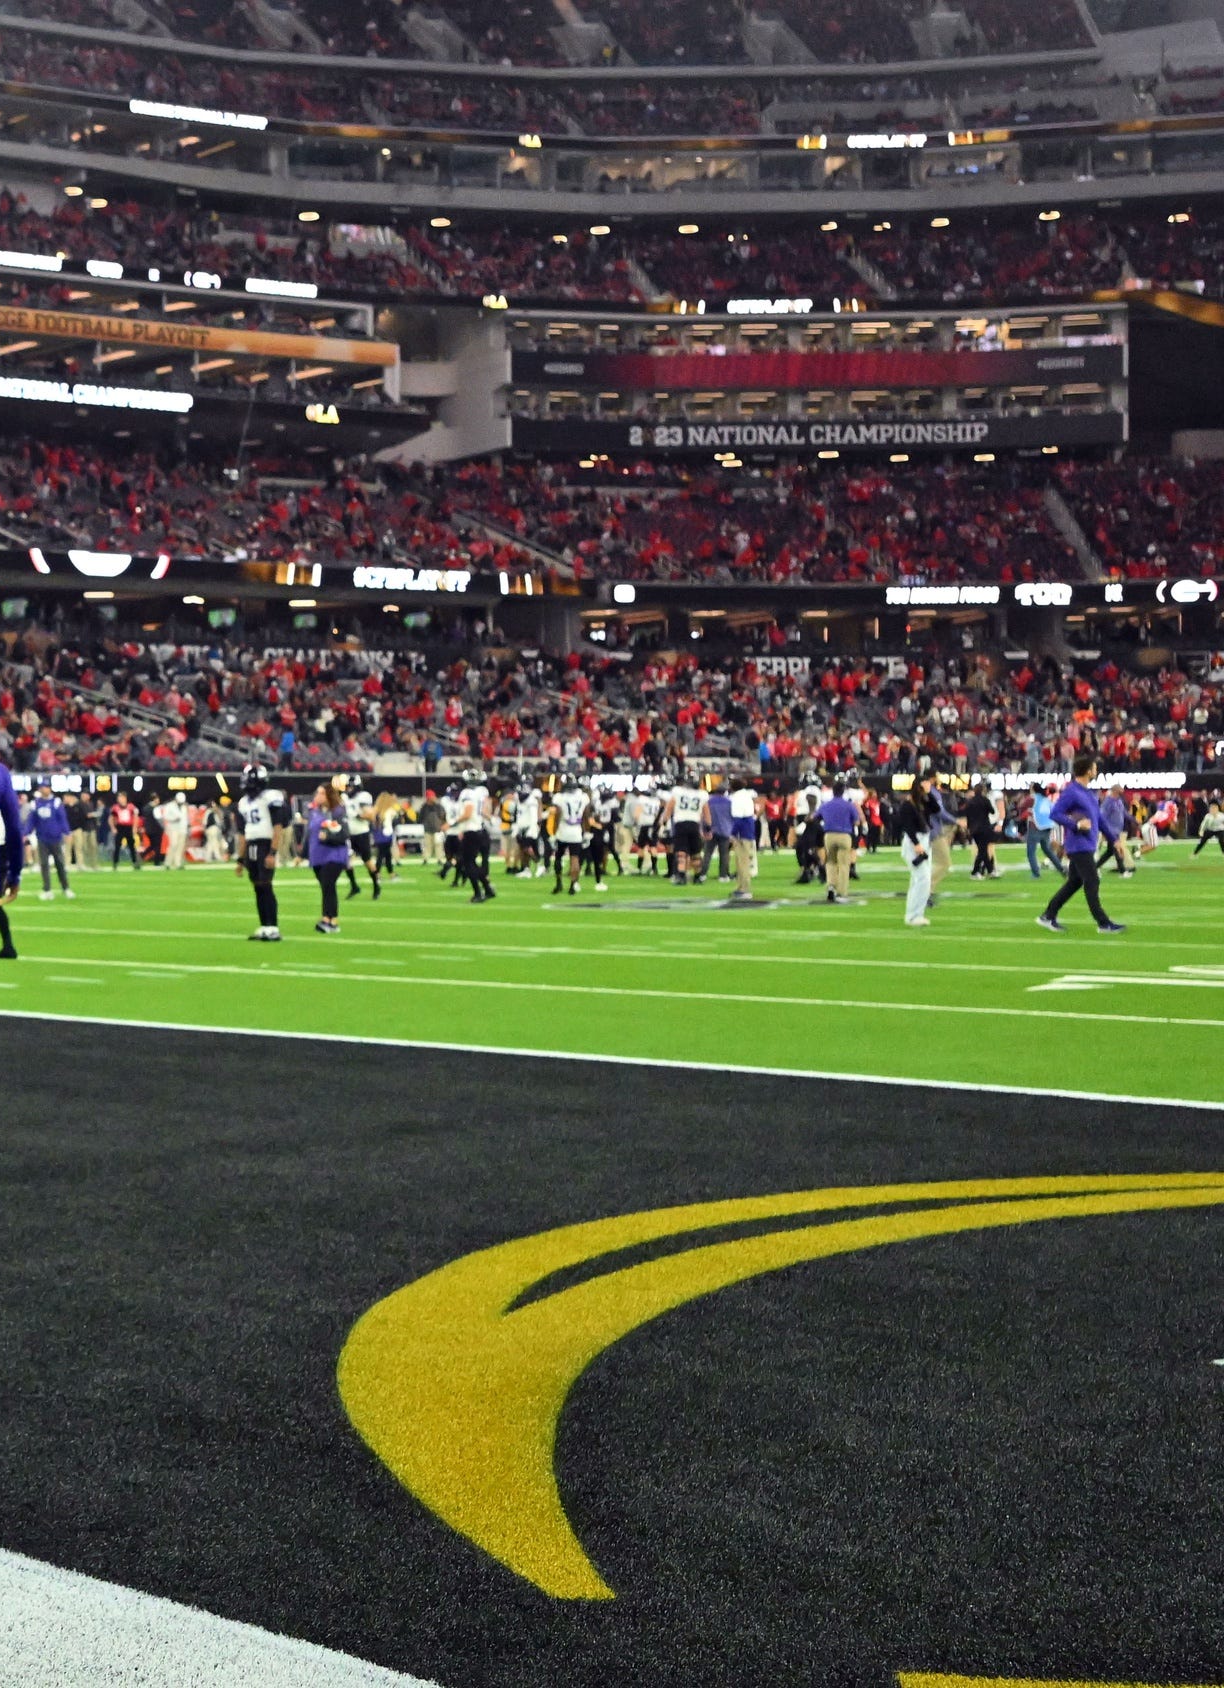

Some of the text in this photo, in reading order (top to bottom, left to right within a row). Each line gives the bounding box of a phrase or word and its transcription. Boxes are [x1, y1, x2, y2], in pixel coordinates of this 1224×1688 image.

[35, 313, 127, 338] FOOTBALL
[133, 323, 211, 345] PLAYOFF
[688, 424, 805, 446] NATIONAL
[809, 422, 989, 445] CHAMPIONSHIP
